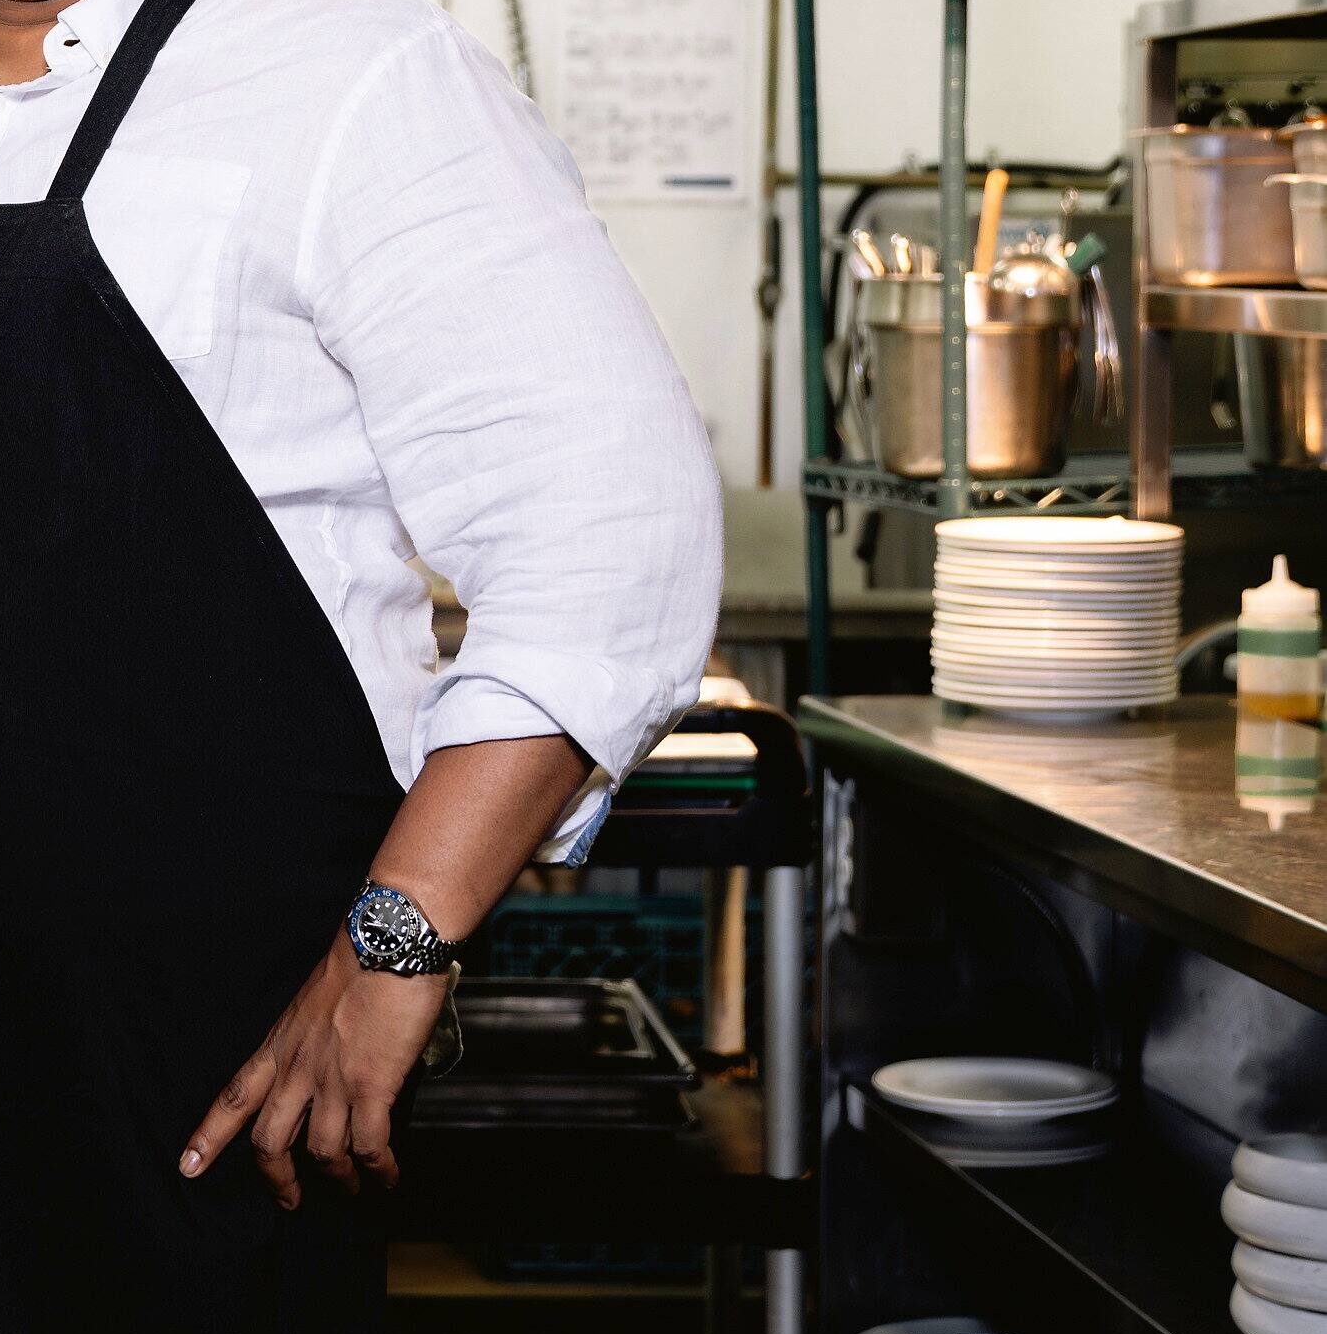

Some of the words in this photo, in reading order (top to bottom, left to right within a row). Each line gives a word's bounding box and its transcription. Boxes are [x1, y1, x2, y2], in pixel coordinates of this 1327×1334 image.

[396, 894, 406, 904] 18
[406, 905, 415, 919] 20
[409, 923, 417, 937] 22
